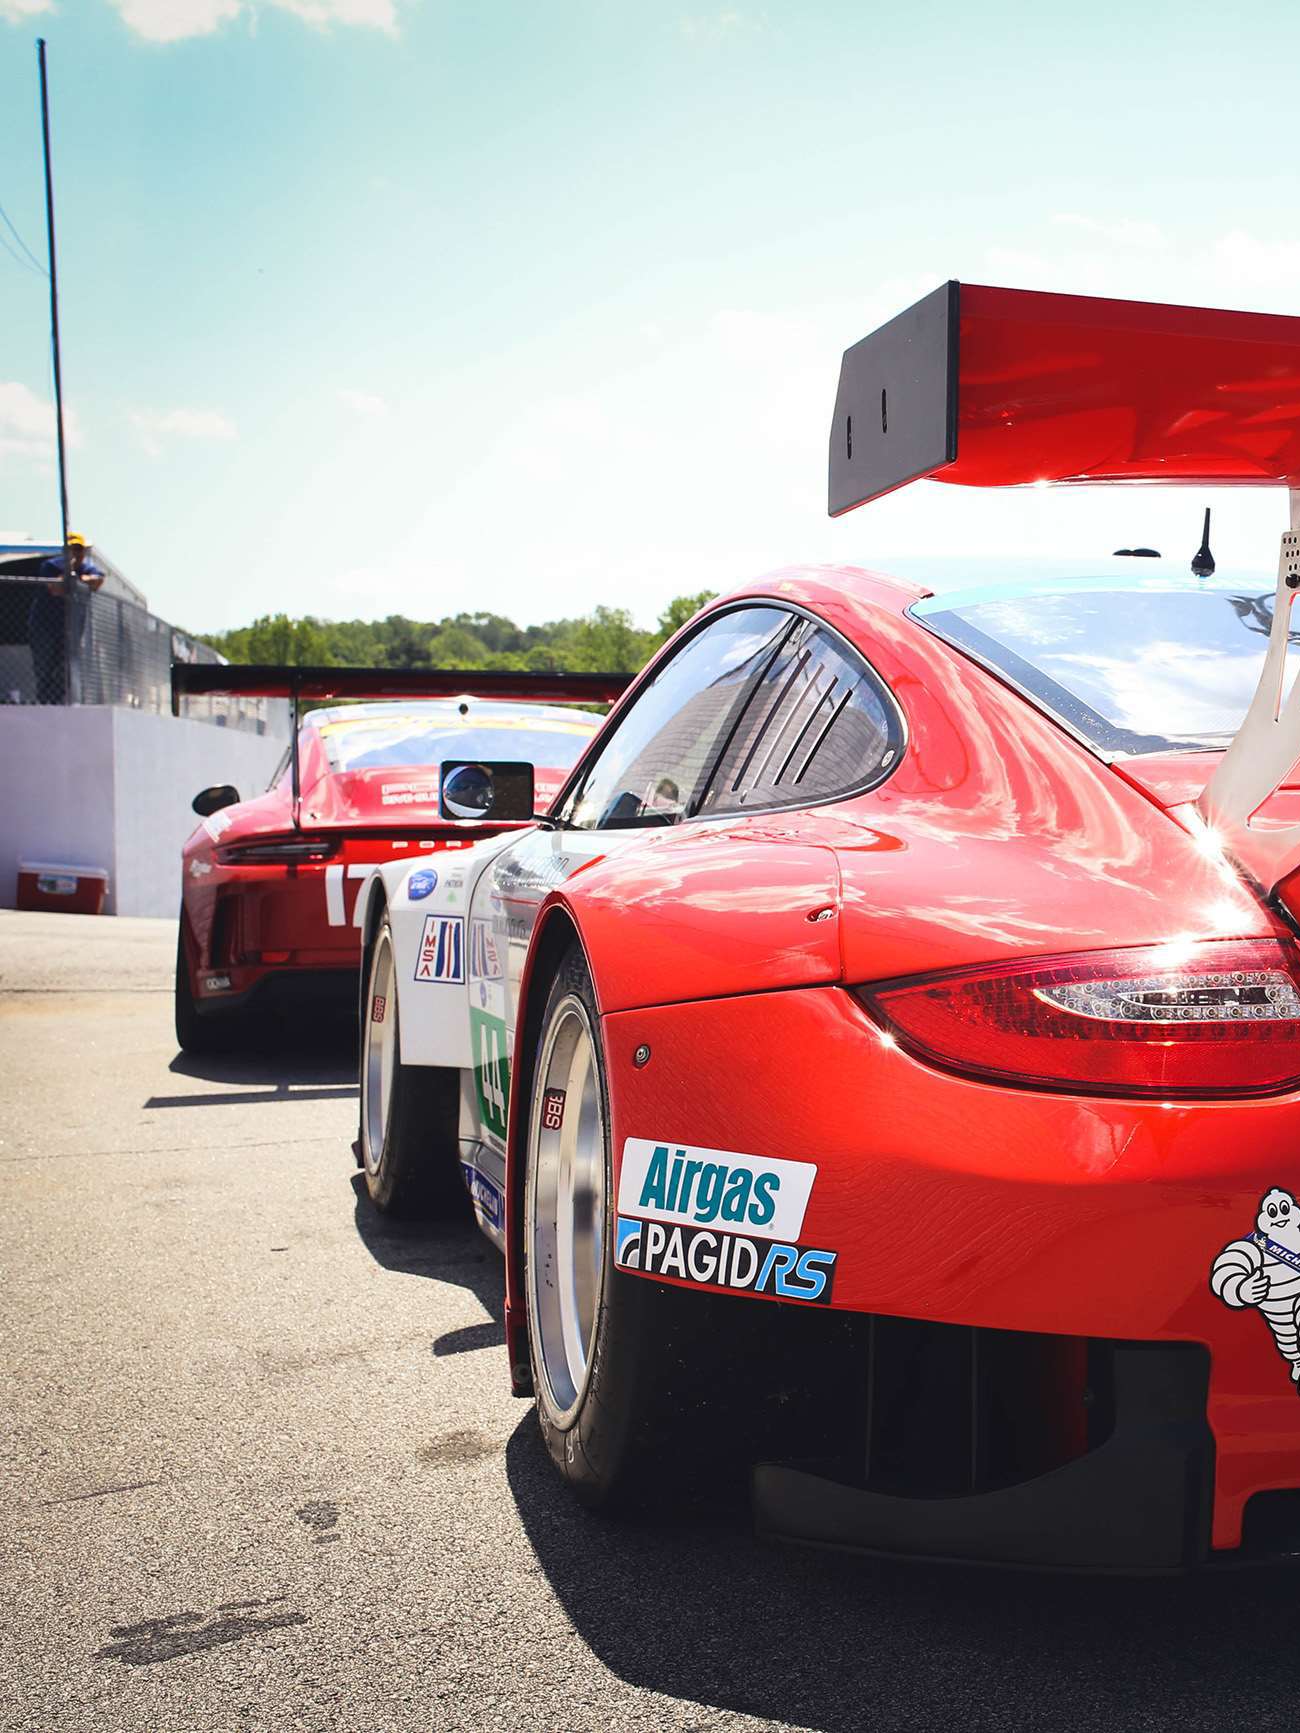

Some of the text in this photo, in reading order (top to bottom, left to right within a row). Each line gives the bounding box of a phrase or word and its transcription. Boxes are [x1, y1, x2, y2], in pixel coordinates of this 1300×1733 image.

[420, 920, 436, 976] IMSA
[373, 997, 385, 1022] BBS
[480, 1024, 506, 1128] 44
[638, 1146, 780, 1225] Airgas
[645, 1223, 836, 1299] PAGID RS
